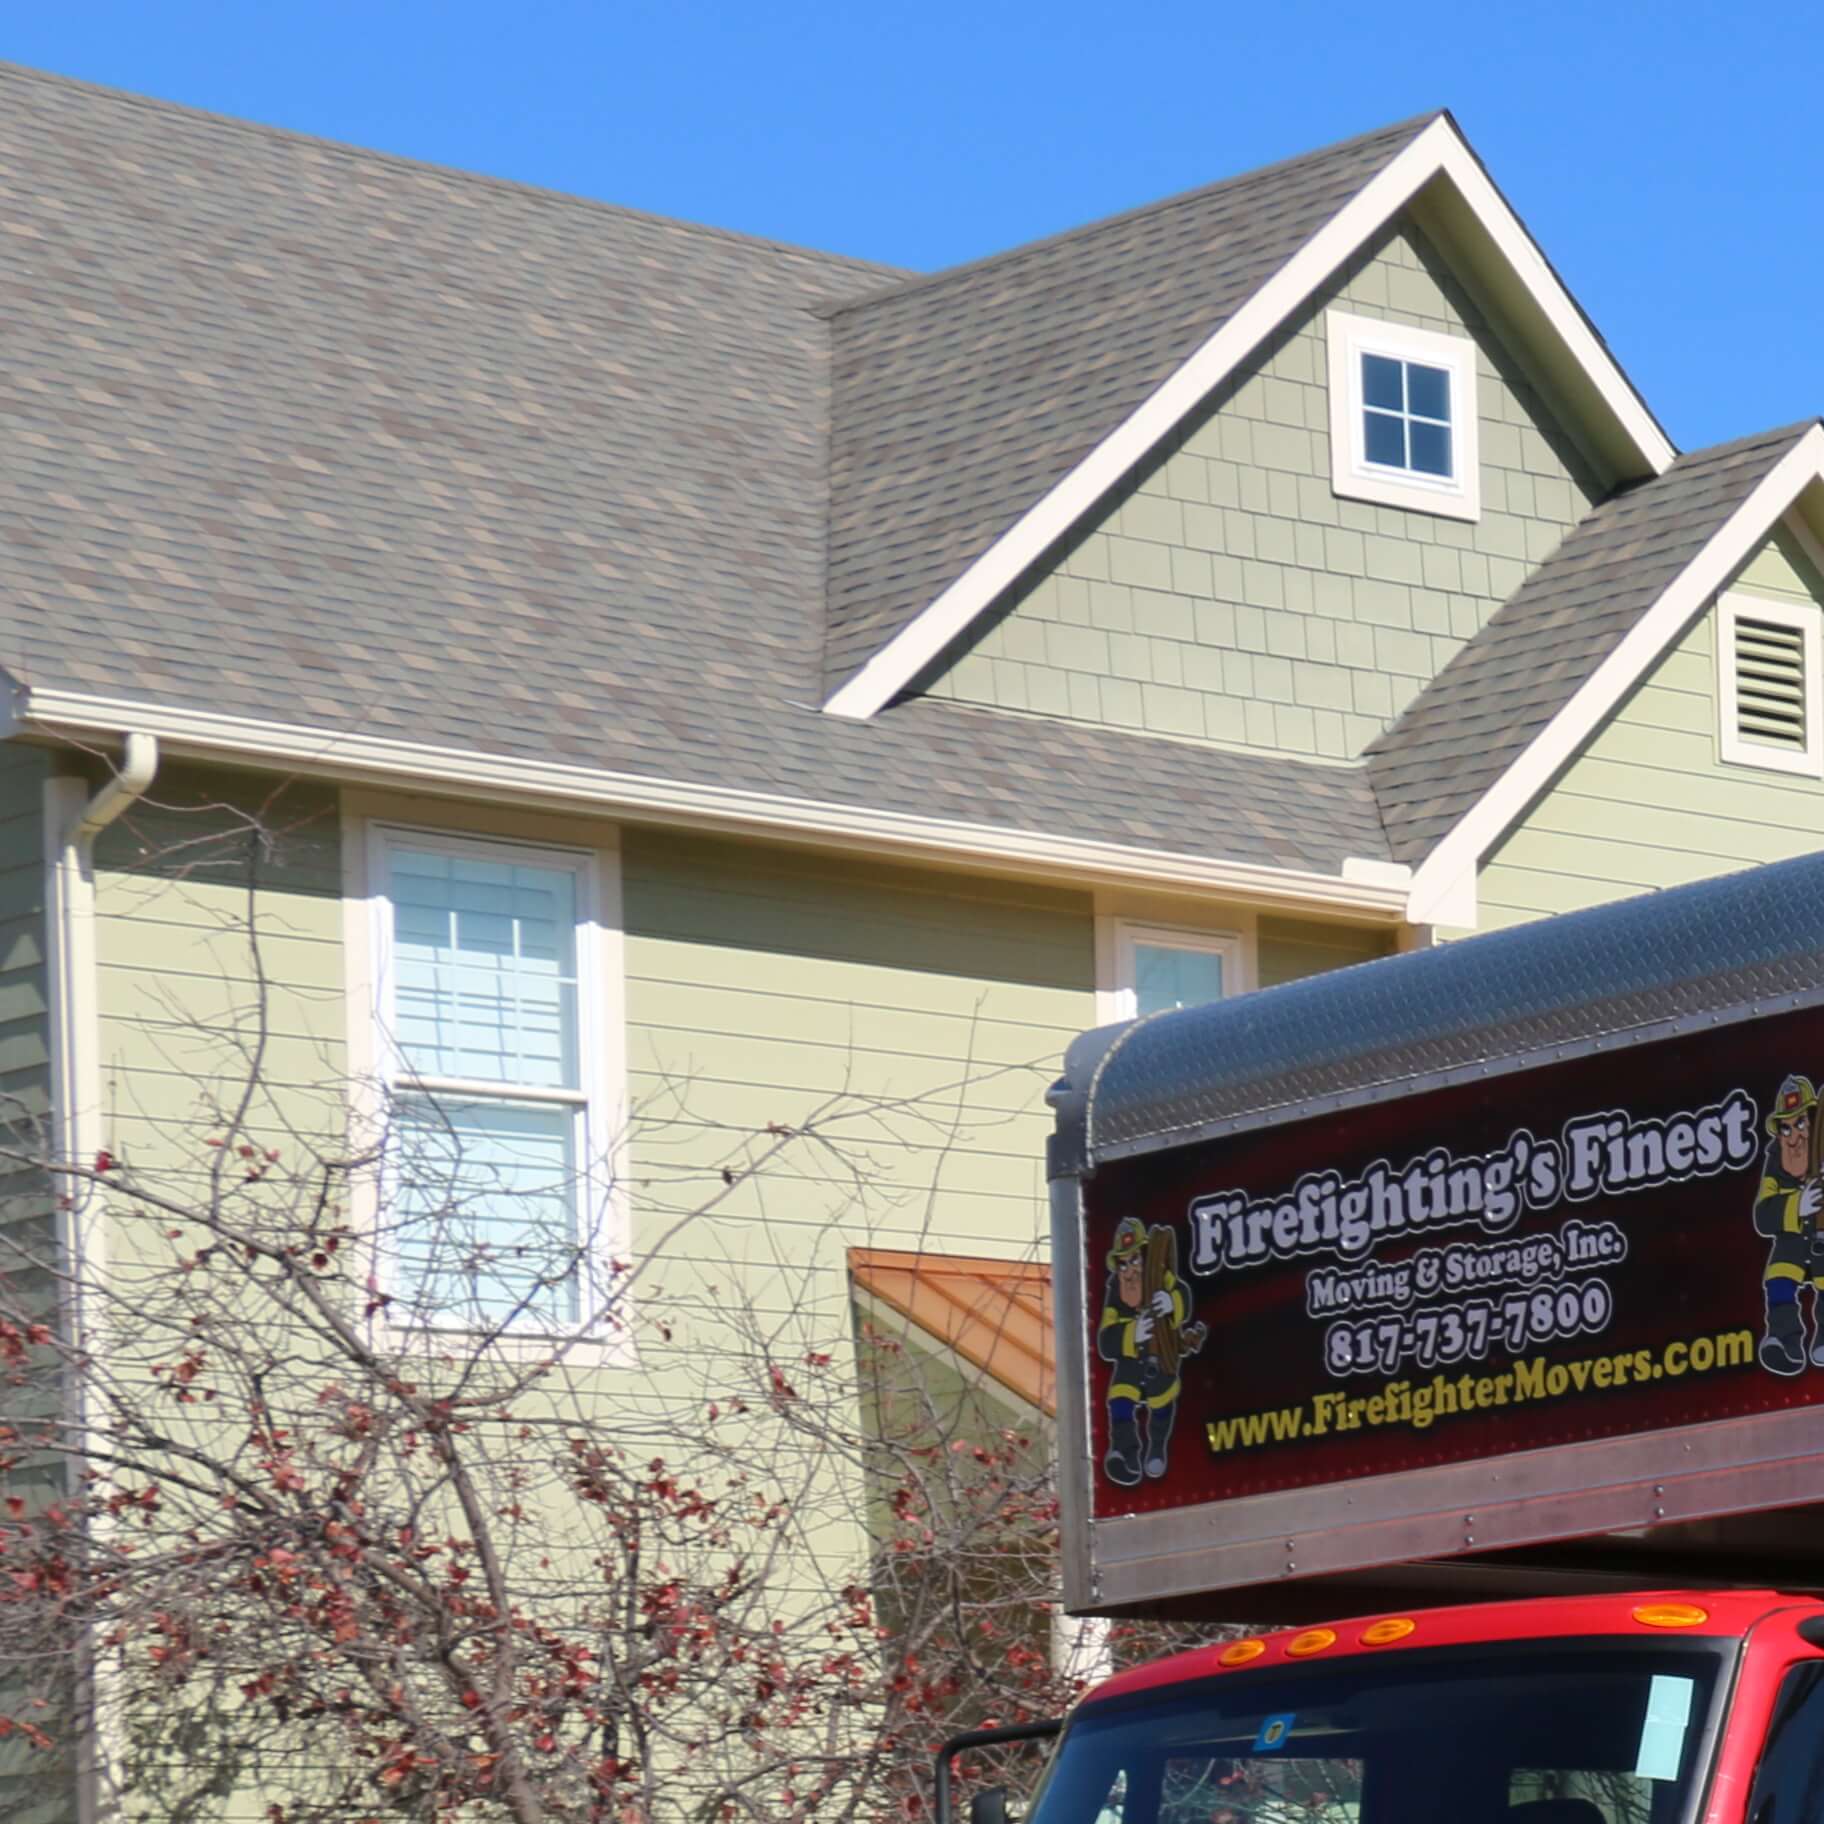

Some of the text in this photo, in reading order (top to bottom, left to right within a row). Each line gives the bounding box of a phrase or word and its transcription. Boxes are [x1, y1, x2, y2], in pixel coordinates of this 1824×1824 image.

[1195, 1096, 1752, 1264] Firefighting's Finest
[1312, 1226, 1622, 1312] Moving & Storage, Inc.
[1329, 1288, 1606, 1374] 817-737-7800
[1206, 1329, 1753, 1451] www.FirefighterMovers.com
